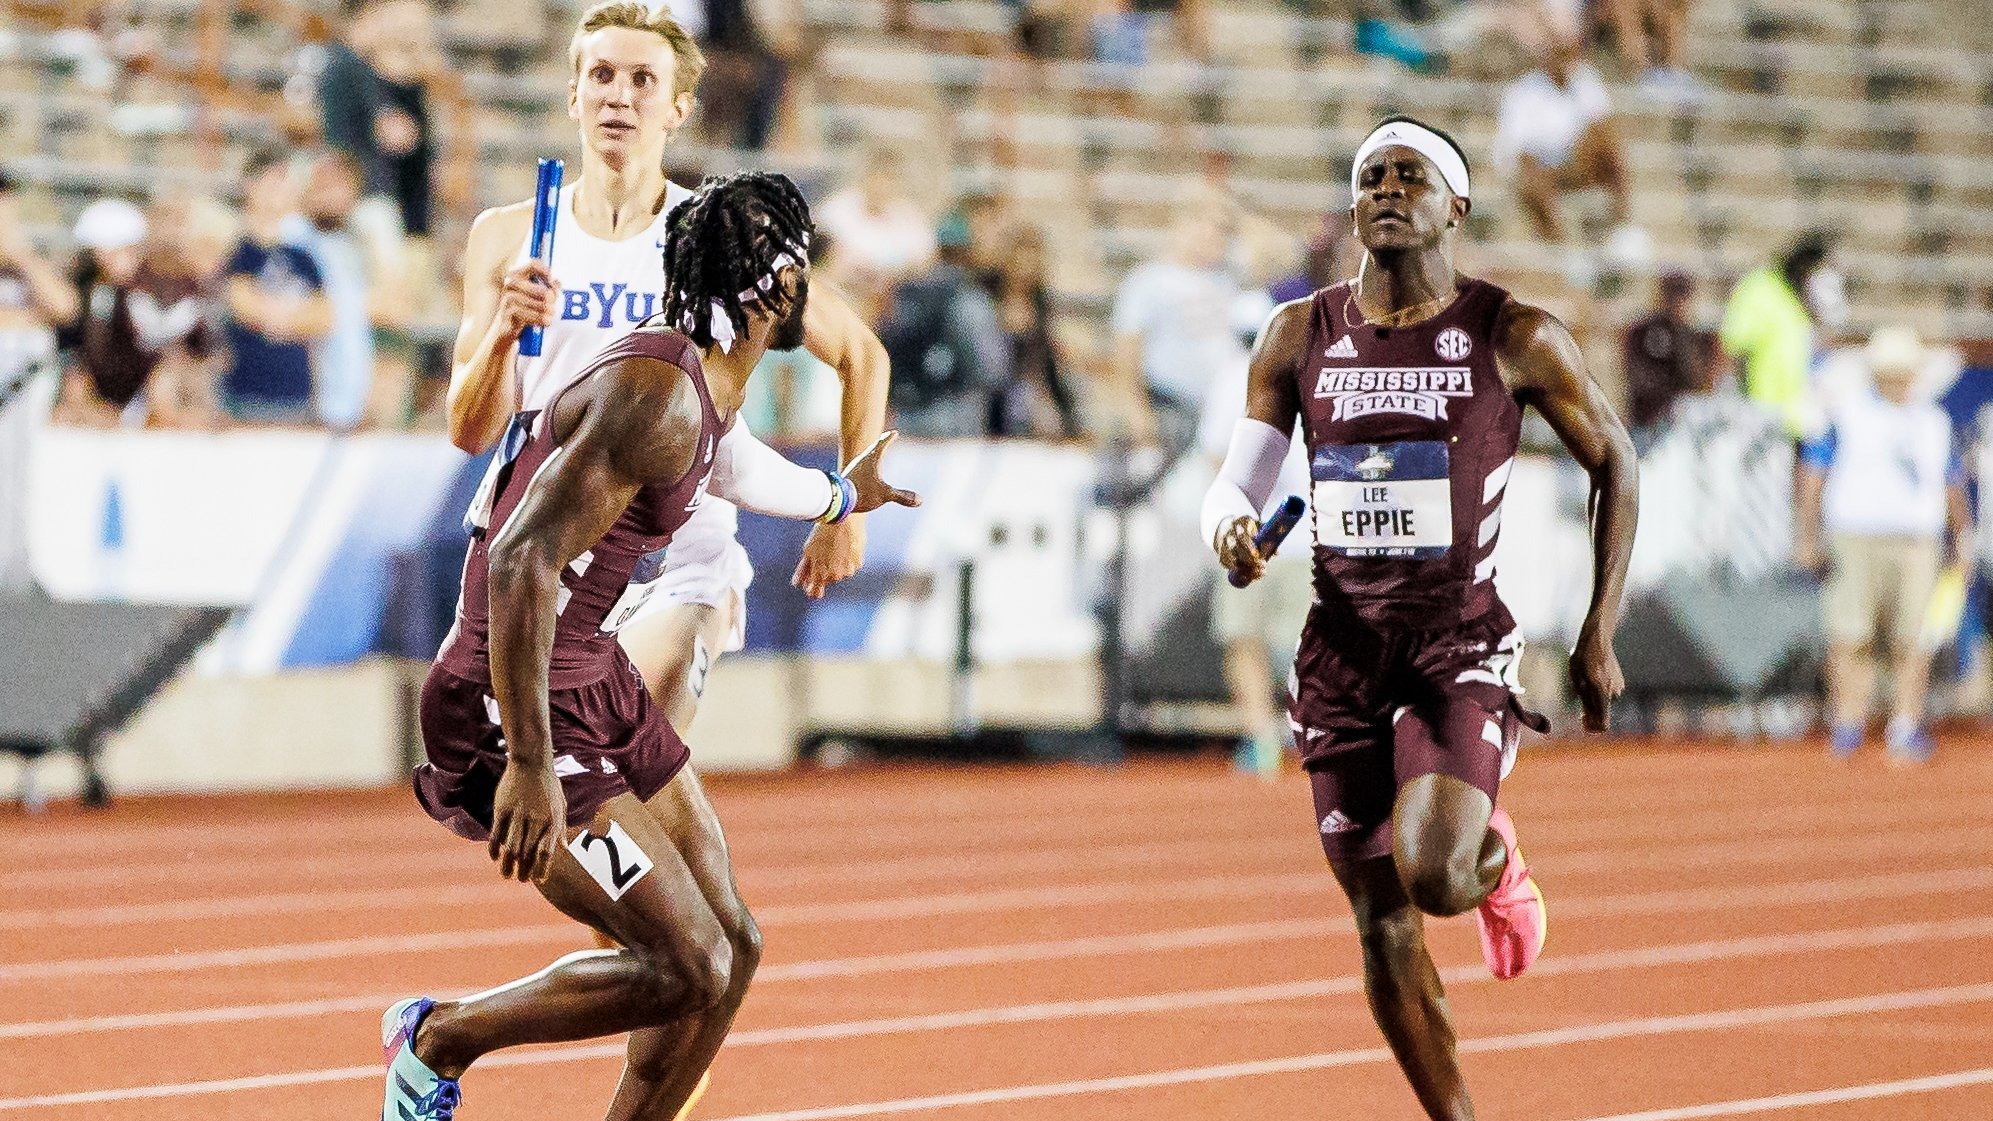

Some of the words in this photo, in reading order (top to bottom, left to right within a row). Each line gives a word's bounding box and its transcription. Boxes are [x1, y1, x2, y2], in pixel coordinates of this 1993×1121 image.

[562, 282, 656, 328] BYU
[1438, 329, 1470, 360] SEC
[1316, 371, 1472, 393] MISSISSIPPI
[1352, 396, 1426, 413] STATE
[1363, 487, 1389, 503] LEE
[1341, 510, 1416, 537] EPPIE
[581, 831, 642, 890] 2
